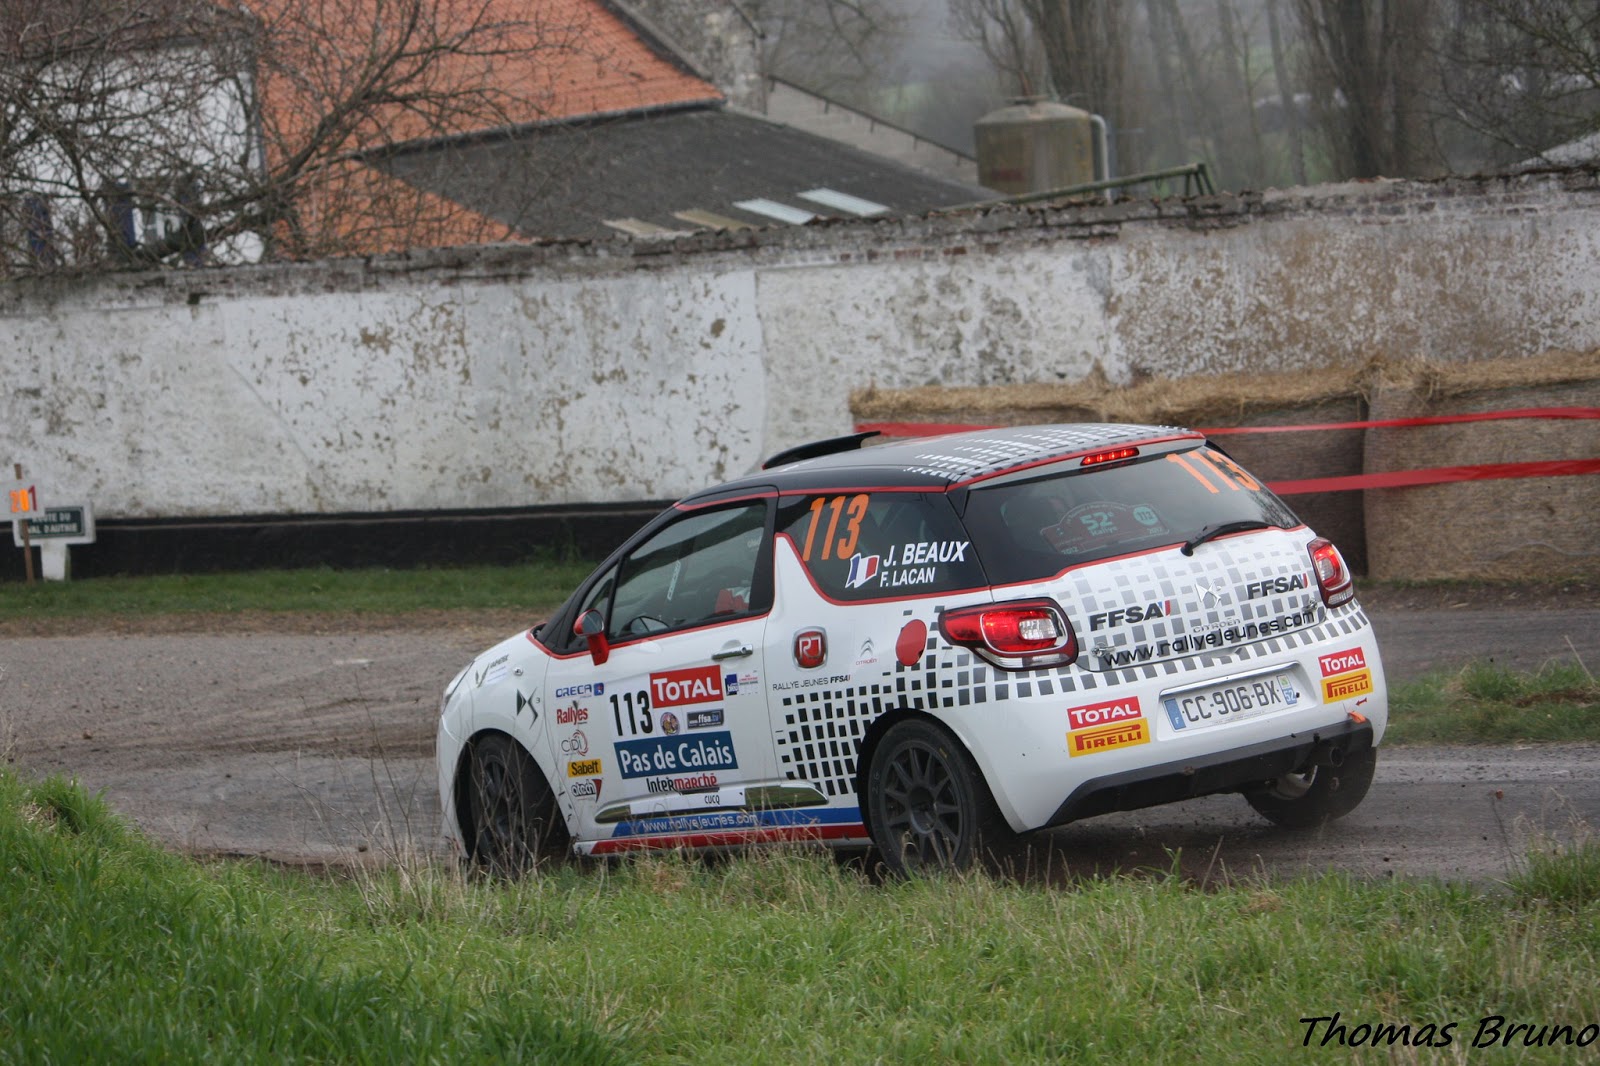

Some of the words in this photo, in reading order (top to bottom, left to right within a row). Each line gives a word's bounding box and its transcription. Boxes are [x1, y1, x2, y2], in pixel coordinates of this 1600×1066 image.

[1166, 450, 1260, 494] 113
[803, 494, 870, 562] 113
[883, 544, 896, 567] J.
[902, 541, 969, 565] BEAUX
[879, 571, 889, 588] F.
[892, 567, 936, 586] LACAN
[1247, 576, 1303, 600] FFSA
[1090, 604, 1165, 631] FFSA
[1104, 609, 1315, 667] www.rallyejeunes.com
[1321, 651, 1365, 673] TOTAL
[556, 684, 592, 698] ORECA
[653, 676, 720, 702] TOTAL
[772, 678, 800, 691] RALLYE
[800, 676, 829, 688] JEUNES
[829, 674, 850, 684] FFSA
[1326, 672, 1369, 698] PIRELLI
[1284, 689, 1296, 702] 52
[556, 706, 589, 726] Rallyes
[610, 690, 653, 736] 113
[1070, 703, 1138, 726] TOTAL
[1075, 723, 1142, 751] PIRELLI
[570, 760, 599, 776] Sabelt
[619, 749, 650, 774] Pas
[653, 744, 676, 770] de
[678, 739, 733, 767] Calais
[704, 794, 720, 804] CUCQ
[642, 813, 759, 834] www.rallyejeunes.com
